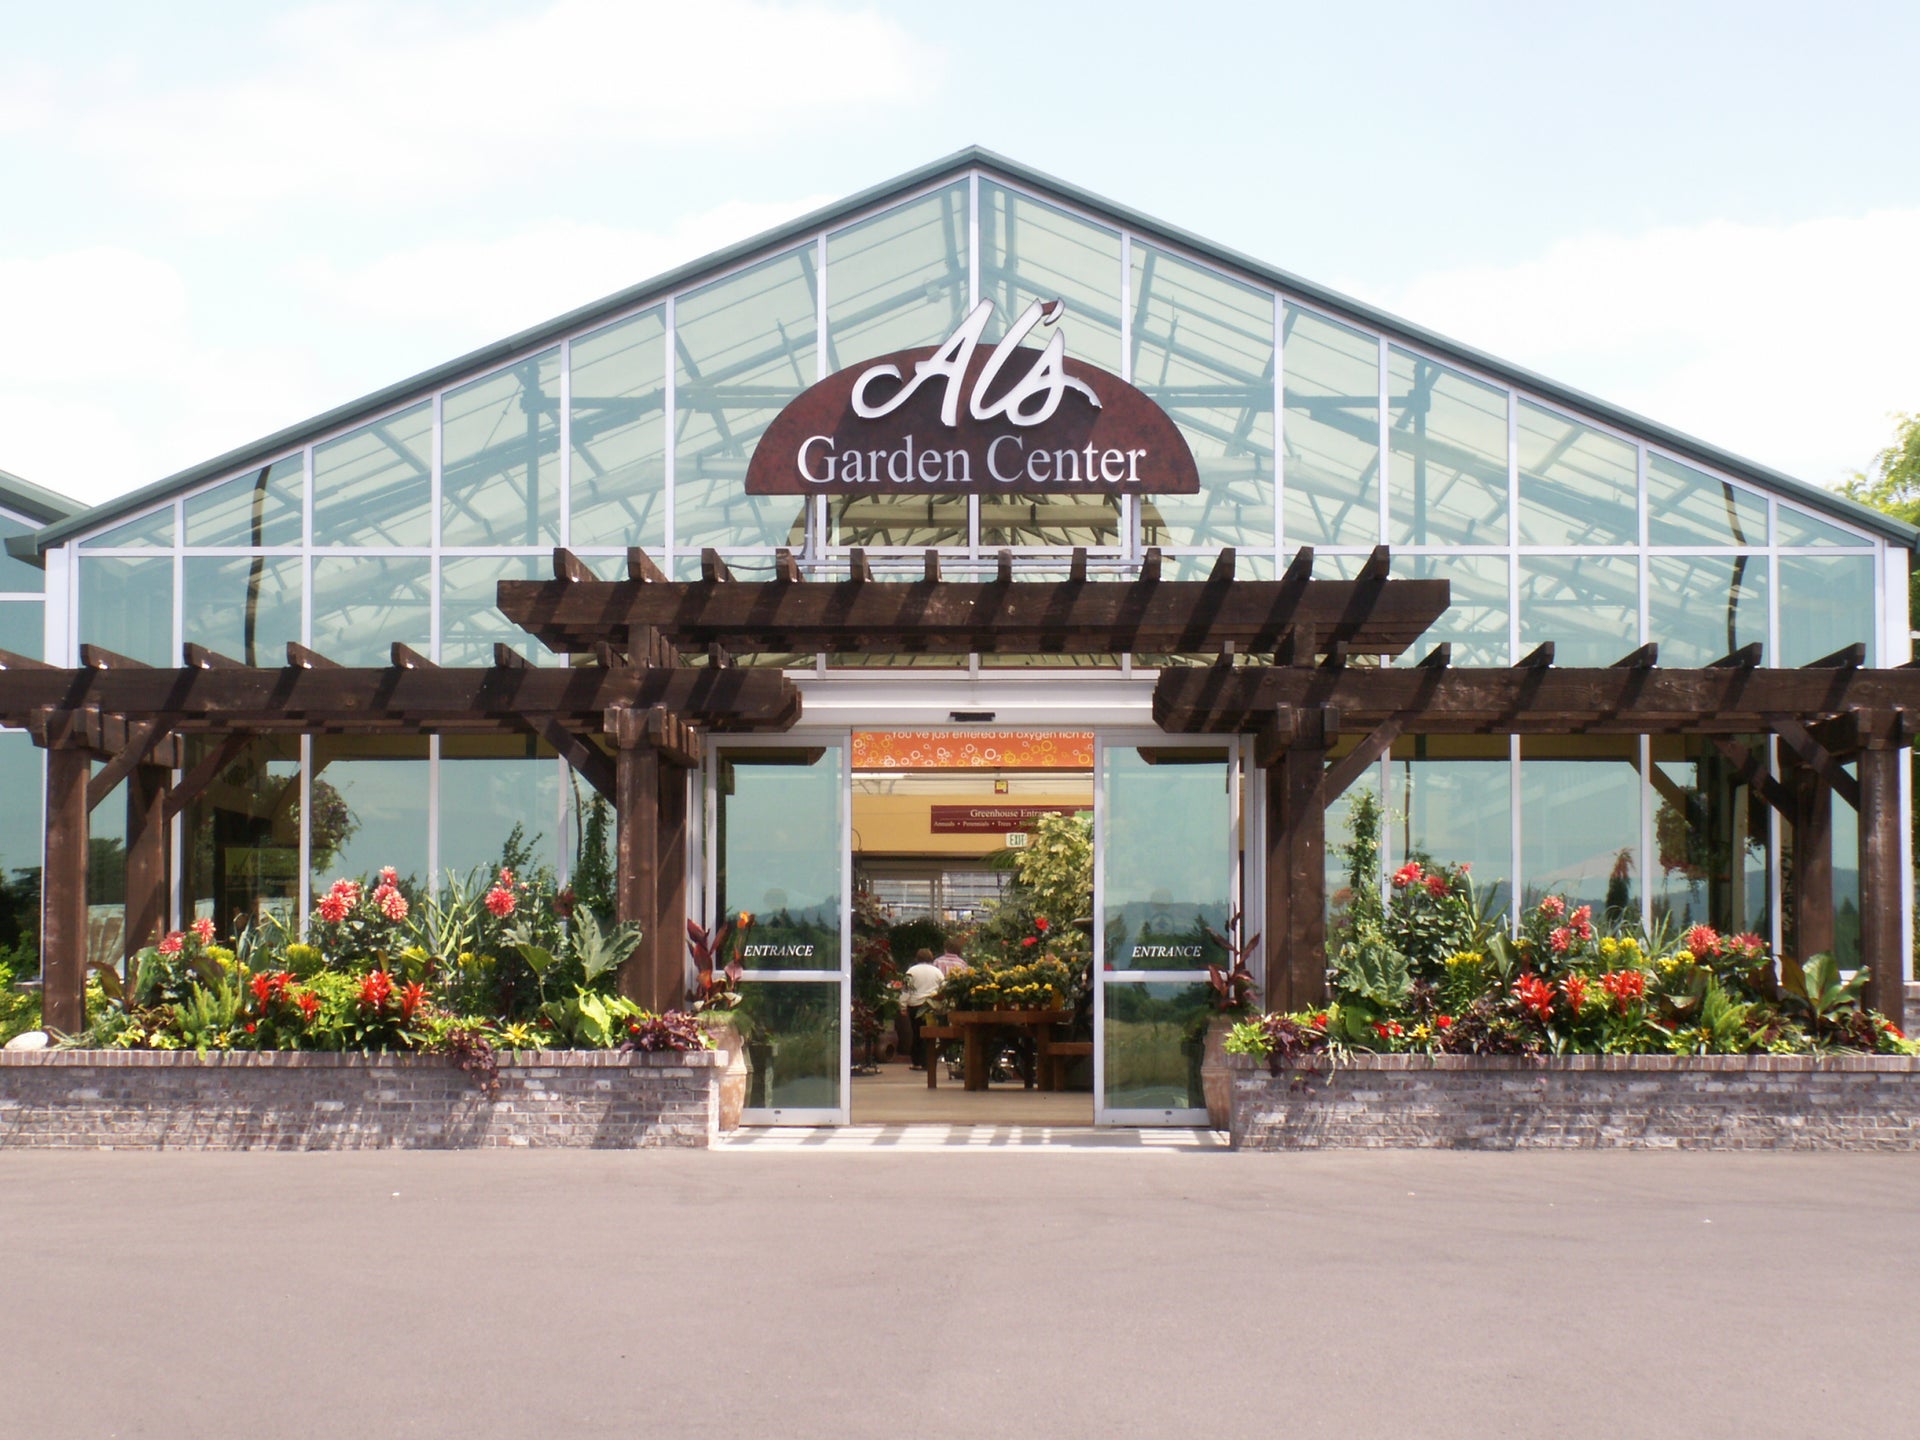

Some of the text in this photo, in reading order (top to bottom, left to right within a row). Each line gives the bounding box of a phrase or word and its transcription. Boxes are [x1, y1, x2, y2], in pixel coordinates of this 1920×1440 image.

[851, 296, 1103, 428] Al's
[797, 434, 1147, 484] Garden Center
[970, 808, 1019, 818] Greenhouse
[1009, 834, 1026, 846] EXIT
[743, 944, 815, 957] ENTRANCE
[1131, 945, 1203, 958] ENTRANCE
